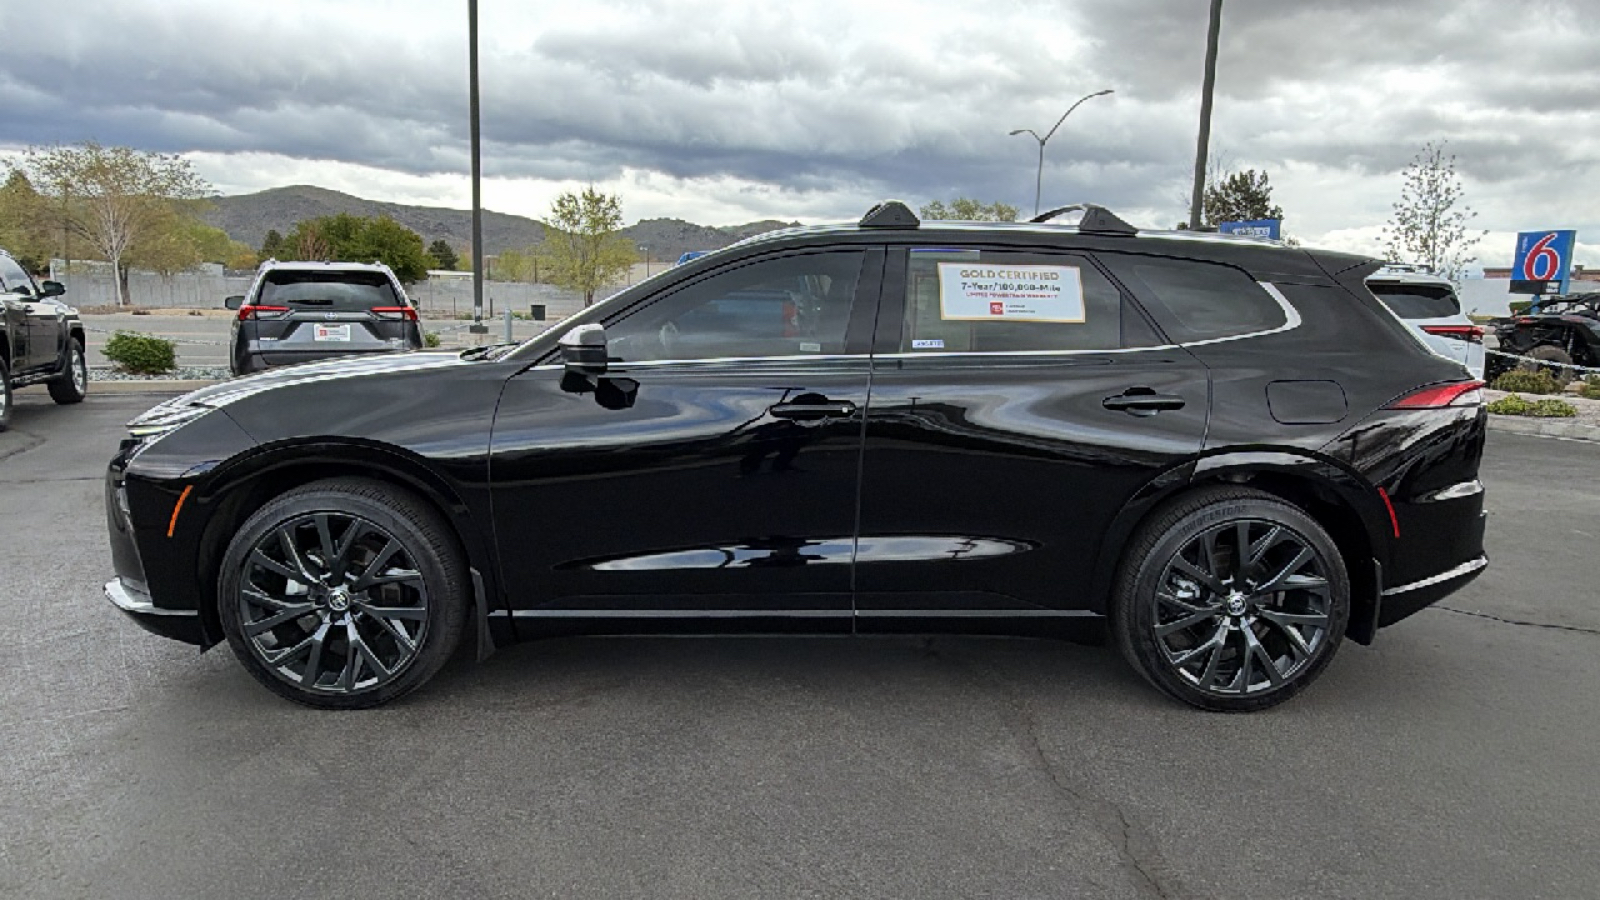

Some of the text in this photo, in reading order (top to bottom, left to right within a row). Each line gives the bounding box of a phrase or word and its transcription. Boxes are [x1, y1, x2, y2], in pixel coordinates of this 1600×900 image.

[1524, 233, 1560, 281] 6
[960, 269, 1060, 281] GOLD CERTIFIED
